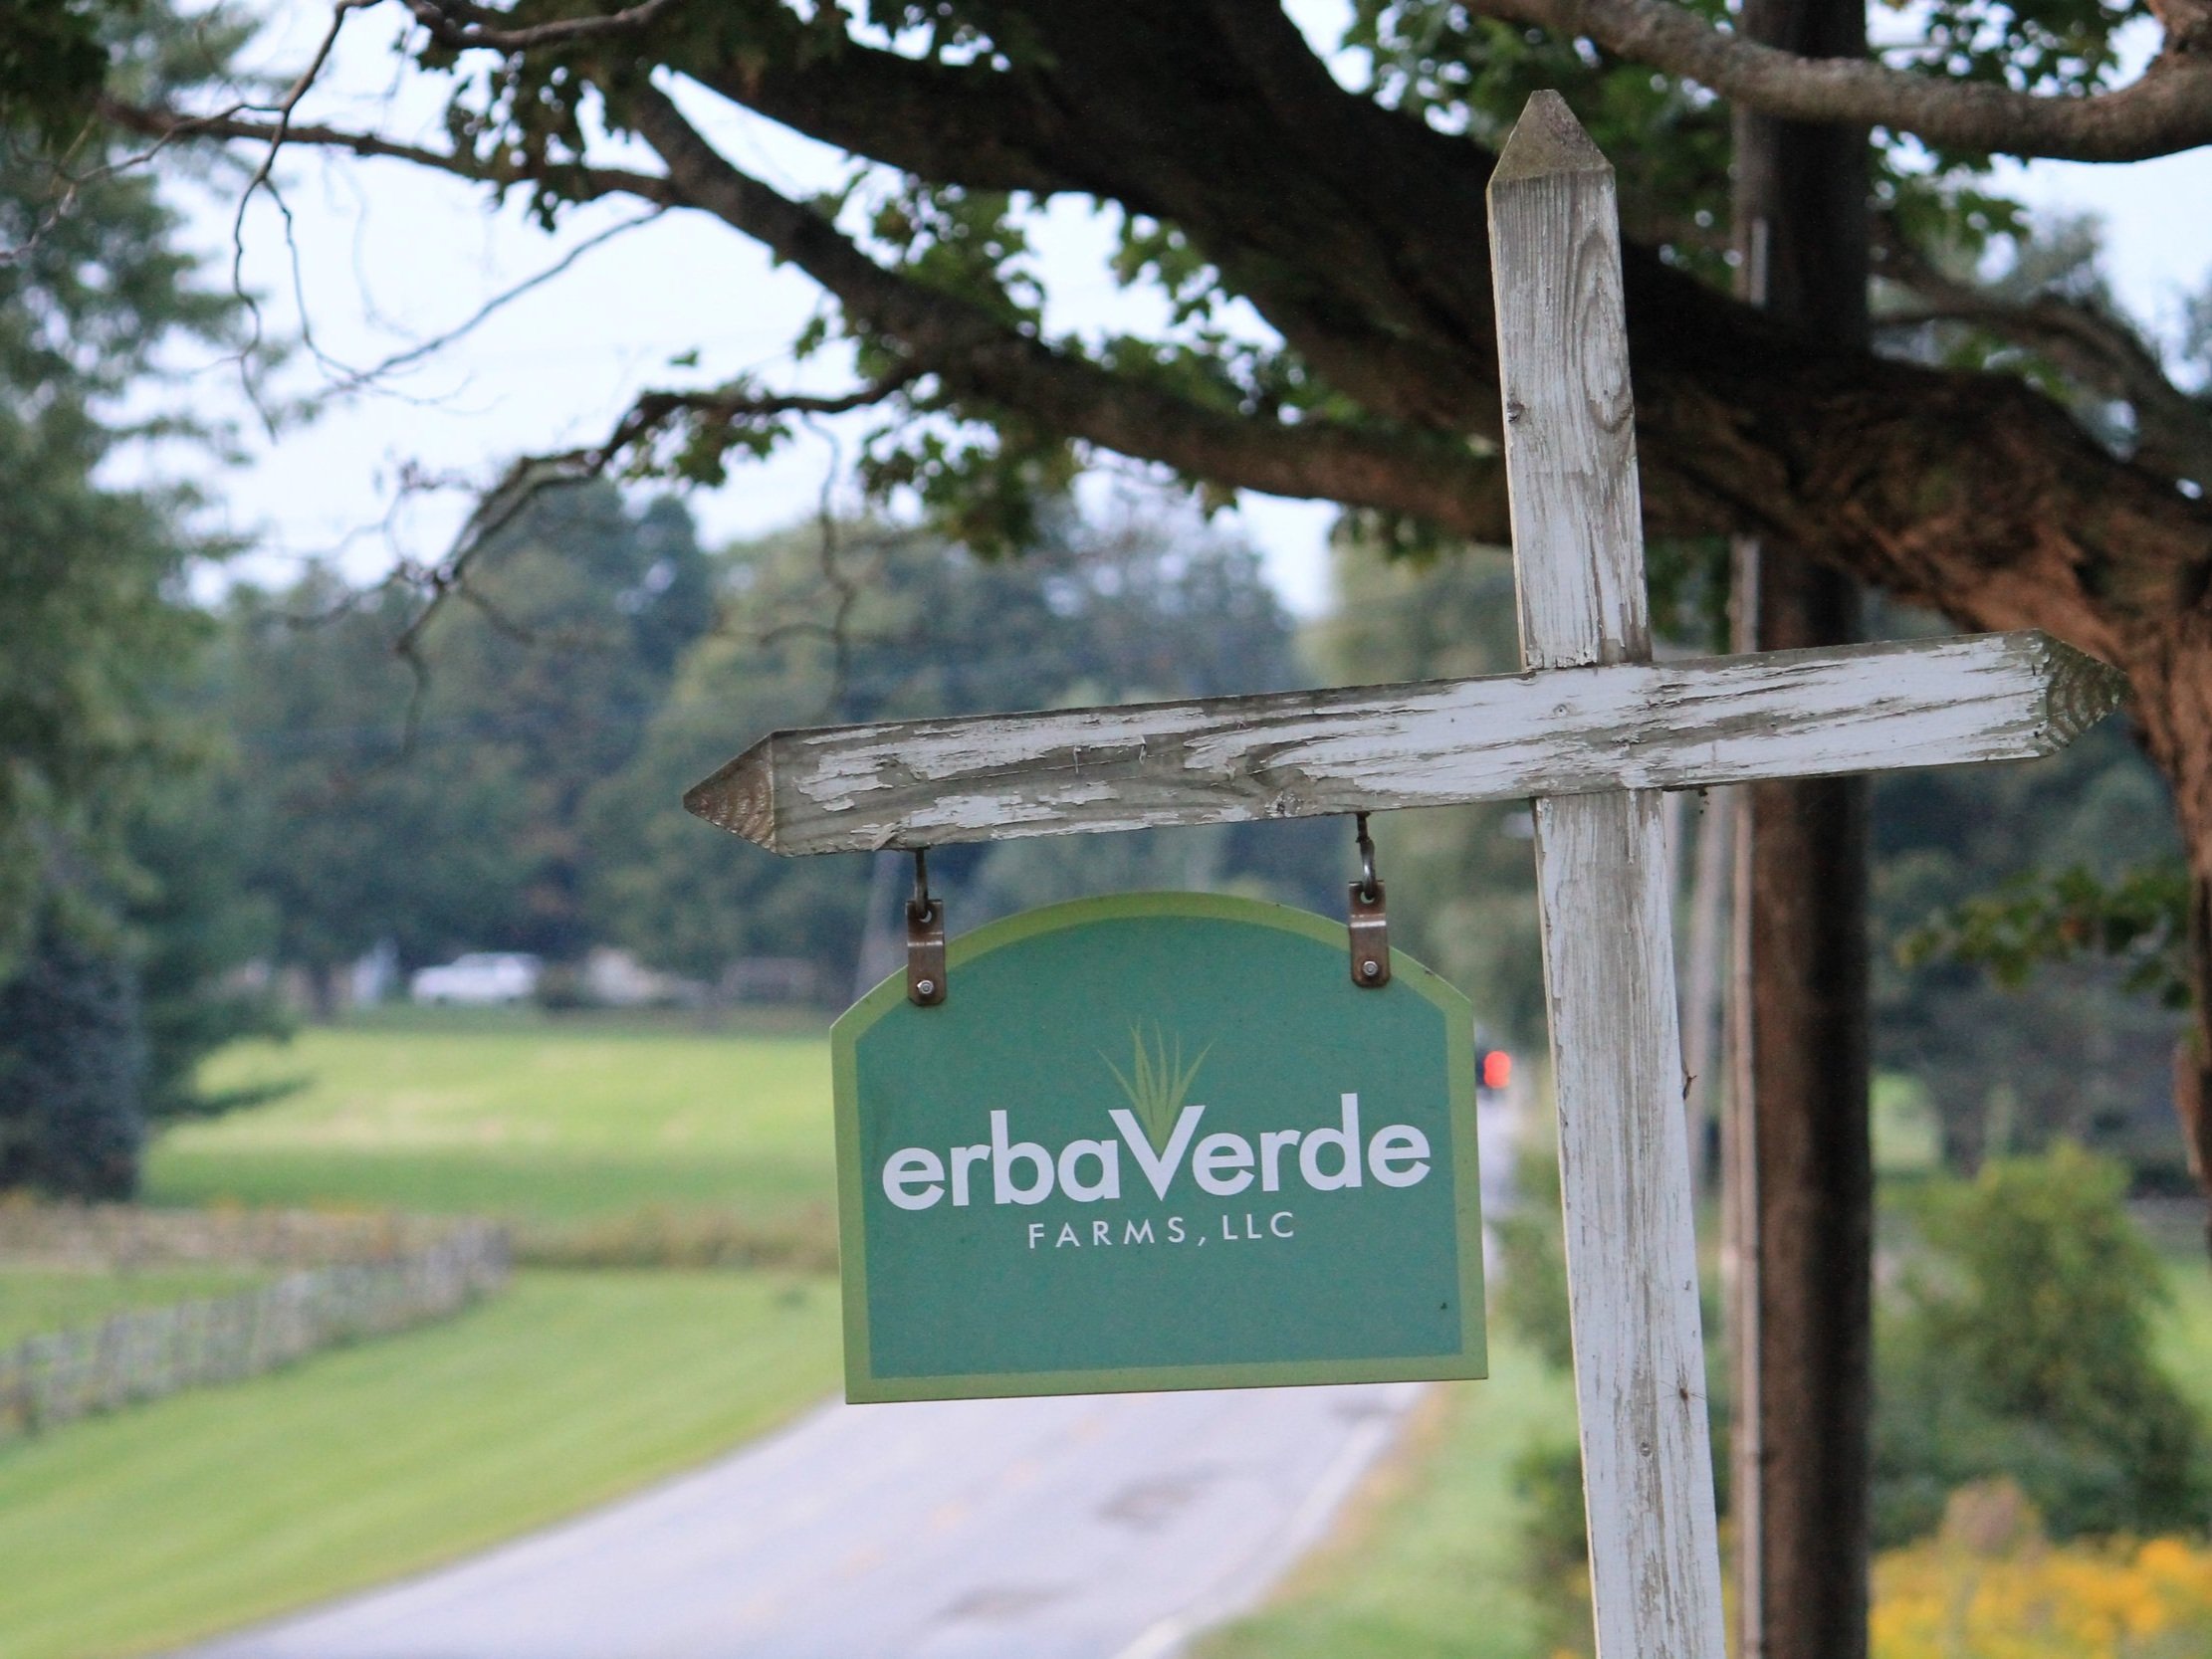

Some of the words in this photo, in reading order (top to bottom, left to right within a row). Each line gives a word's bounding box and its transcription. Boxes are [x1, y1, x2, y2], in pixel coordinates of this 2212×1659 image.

[882, 1093, 1432, 1210] erbaVerde
[1027, 1216, 1207, 1249] FARMS,
[1222, 1211, 1294, 1240] LLC
